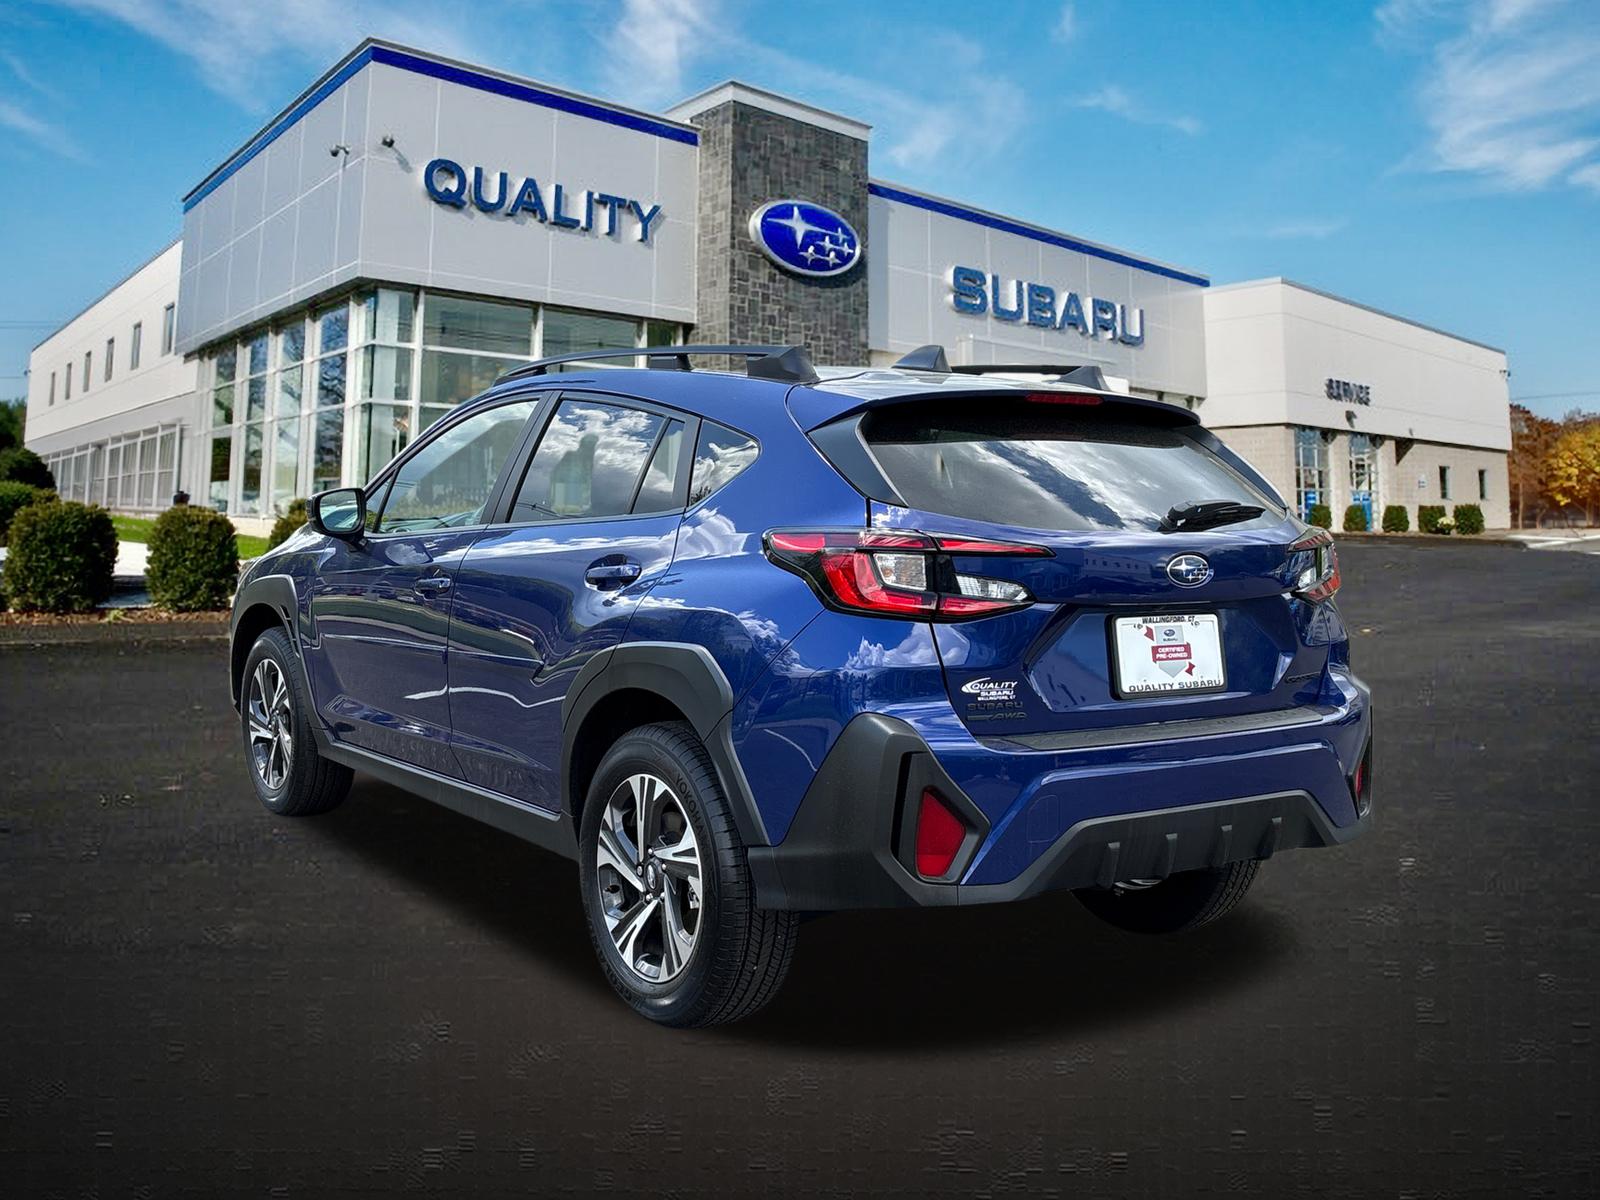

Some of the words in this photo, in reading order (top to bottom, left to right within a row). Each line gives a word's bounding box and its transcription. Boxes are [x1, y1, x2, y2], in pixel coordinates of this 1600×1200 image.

[424, 158, 661, 242] QUALITY
[951, 265, 1144, 347] SUBARU
[970, 681, 1018, 690] QUALITY
[1129, 683, 1174, 691] QUALITY
[1178, 680, 1221, 688] SUBARU
[967, 701, 1023, 710] SUBARU
